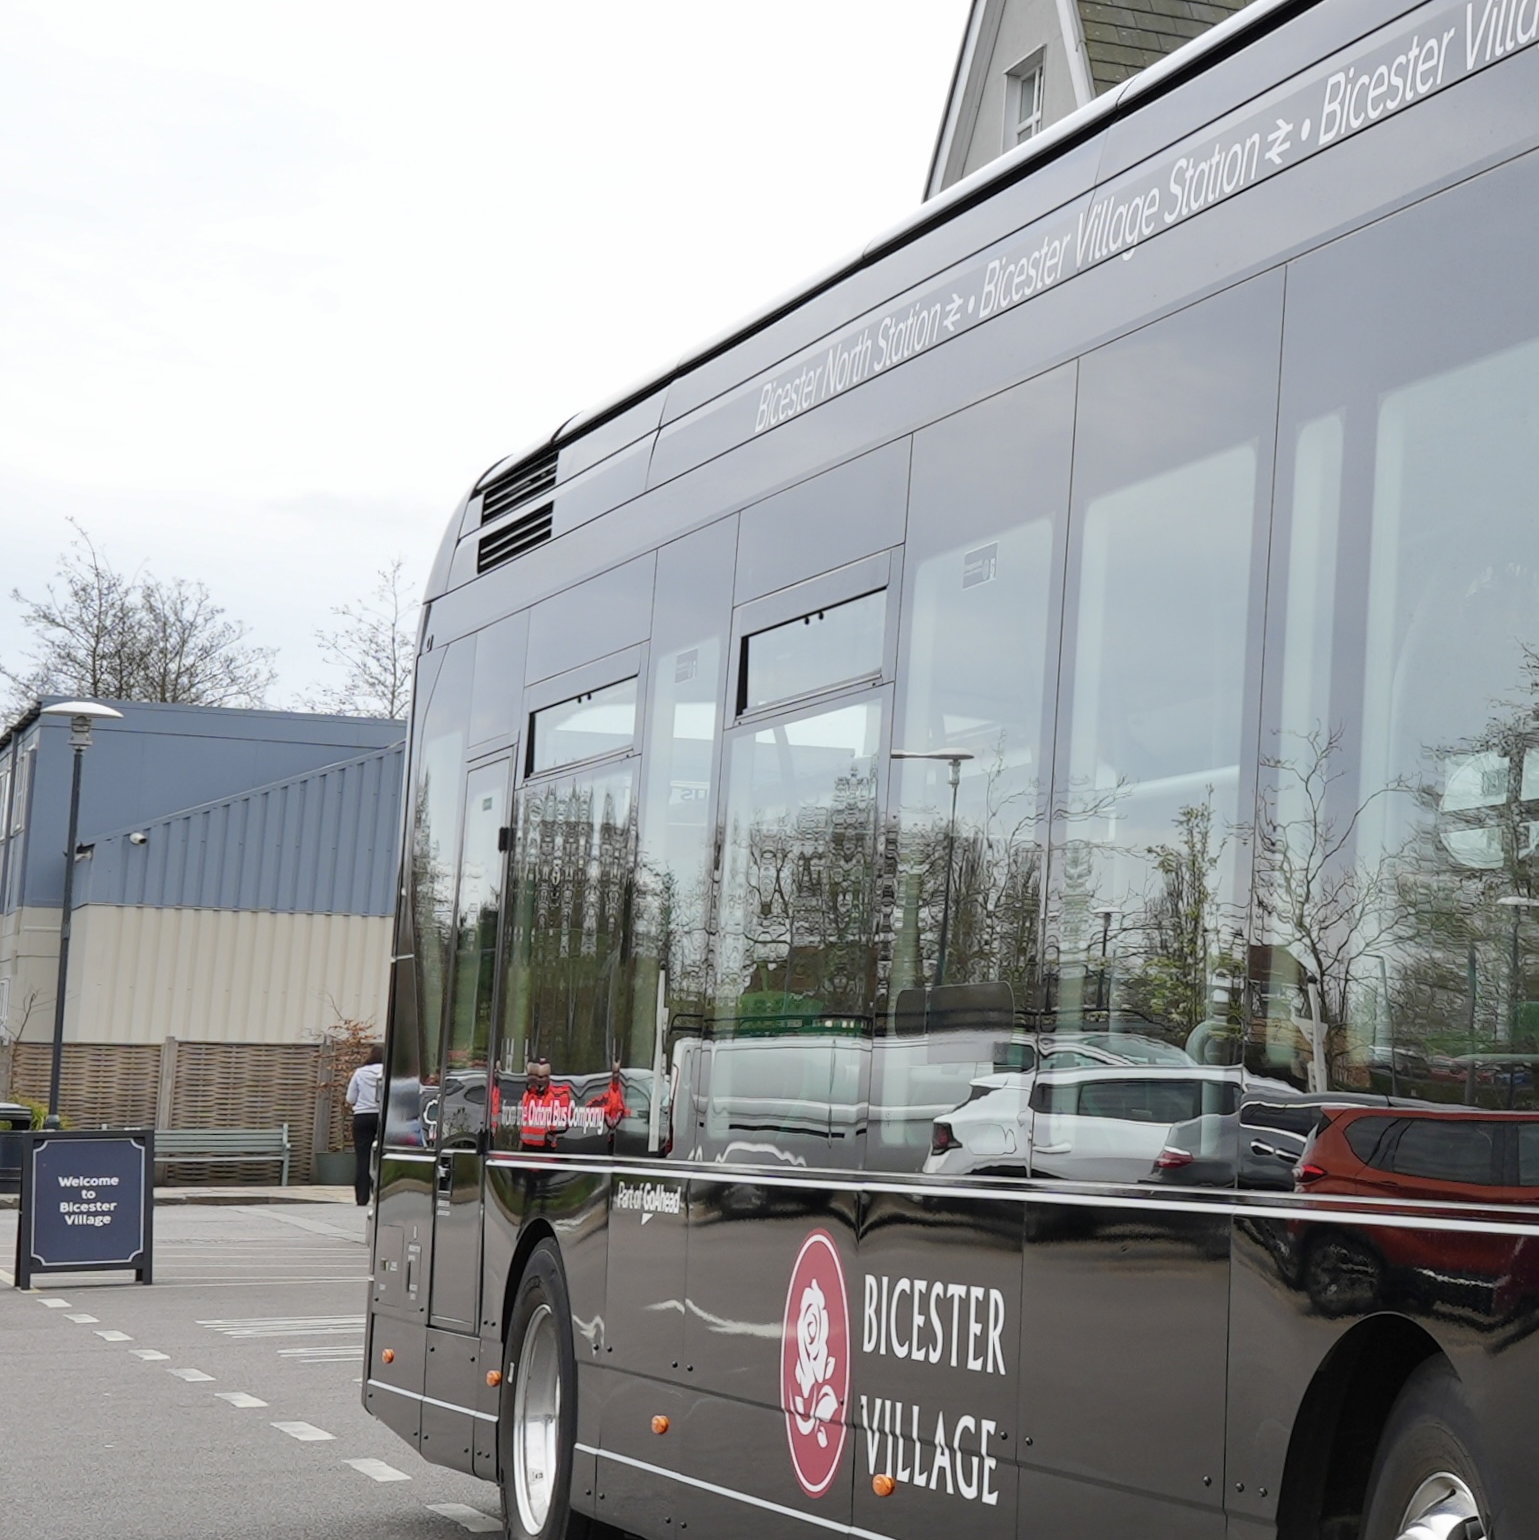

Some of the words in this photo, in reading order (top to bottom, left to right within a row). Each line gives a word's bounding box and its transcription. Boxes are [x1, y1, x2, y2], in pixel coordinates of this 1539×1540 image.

[754, 364, 825, 432] Bicester
[822, 330, 873, 406] North
[873, 299, 942, 372] Station
[979, 232, 1073, 319] Bicester
[1073, 187, 1160, 268] Village
[1163, 132, 1260, 224] Station
[1318, 26, 1455, 146] Bicester
[528, 1100, 551, 1126] Oxford
[553, 1100, 567, 1127] Bus
[568, 1100, 605, 1135] Company
[58, 1176, 120, 1187] Welcome
[81, 1189, 96, 1199] to
[617, 1181, 632, 1209] Part
[60, 1202, 117, 1213] Bicester
[65, 1214, 111, 1227] Village
[862, 1274, 1006, 1375] BICESTER
[860, 1394, 999, 1506] VILLAGE
